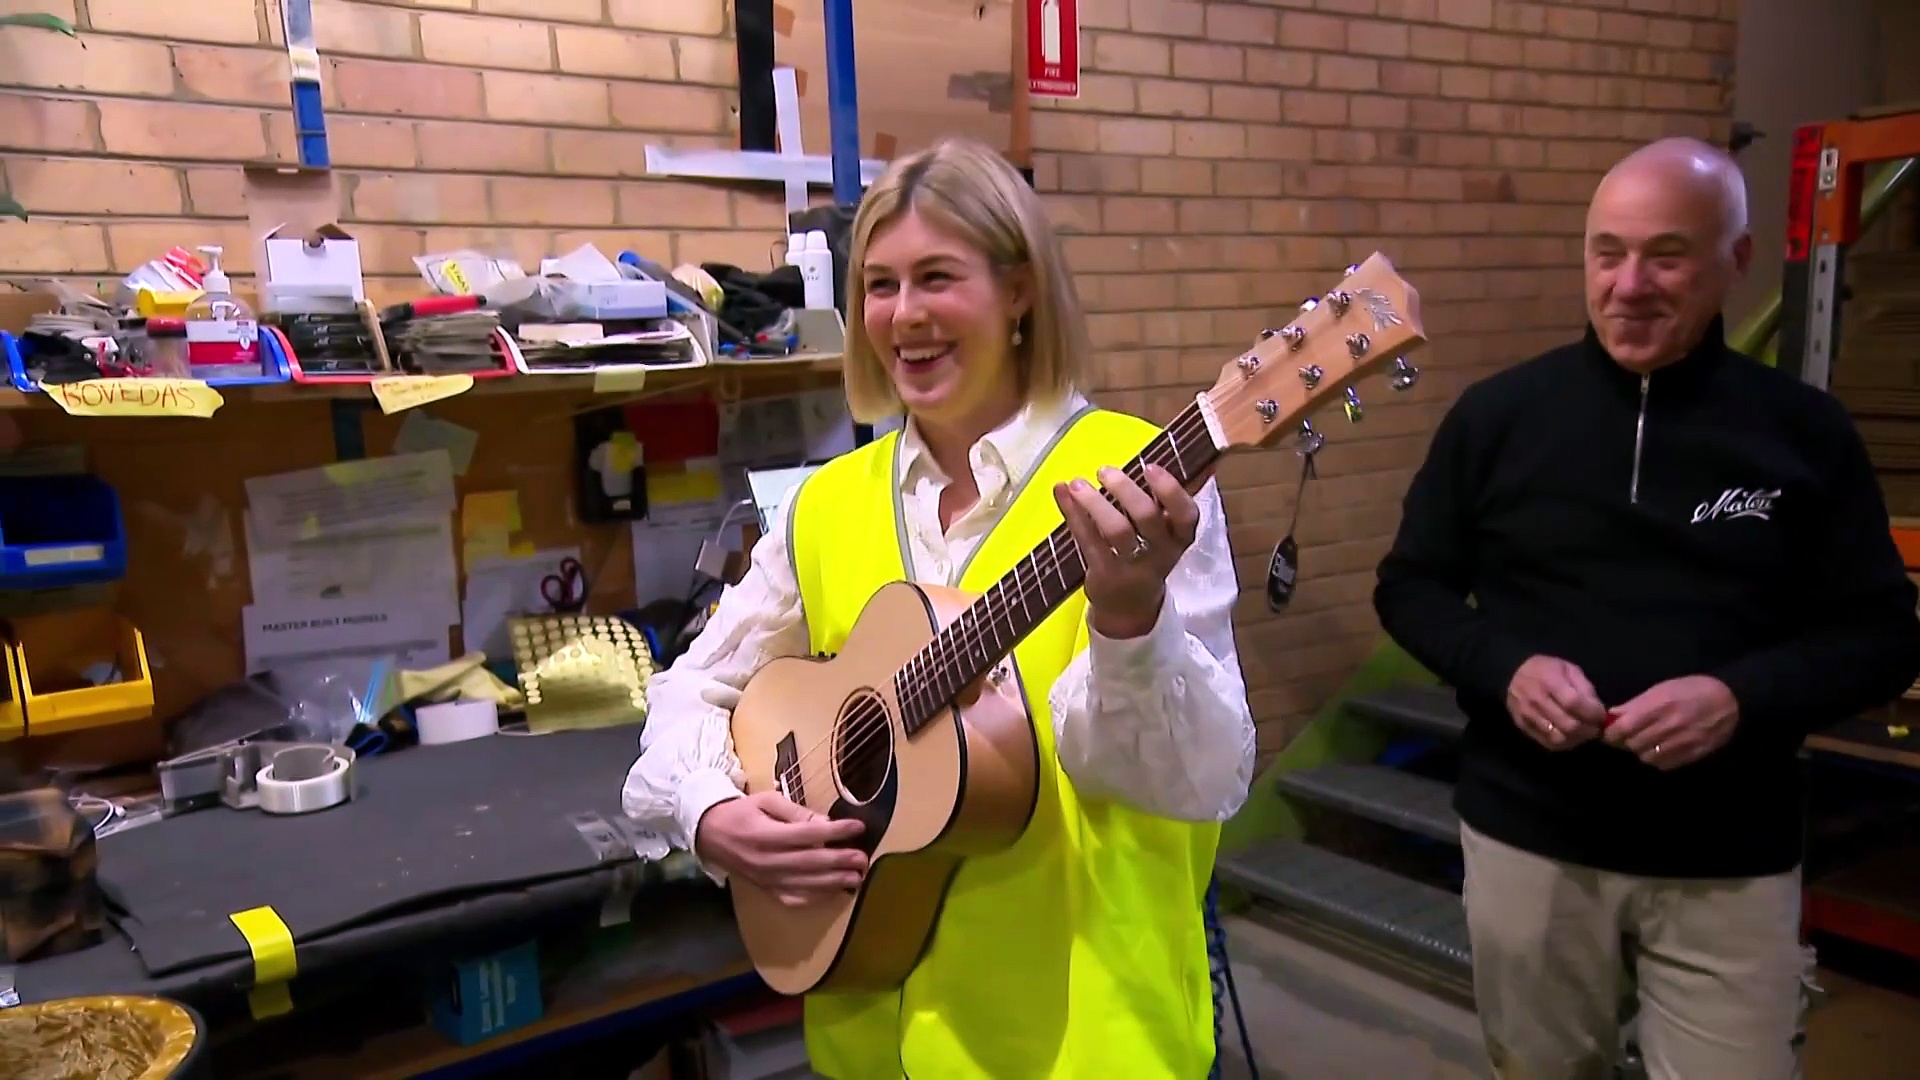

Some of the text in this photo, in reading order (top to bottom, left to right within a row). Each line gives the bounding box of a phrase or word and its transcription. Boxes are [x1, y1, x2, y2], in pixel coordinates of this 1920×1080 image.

[1044, 67, 1060, 78] FIRE
[60, 382, 196, 410] BOVEDAS
[262, 621, 308, 633] MASTER
